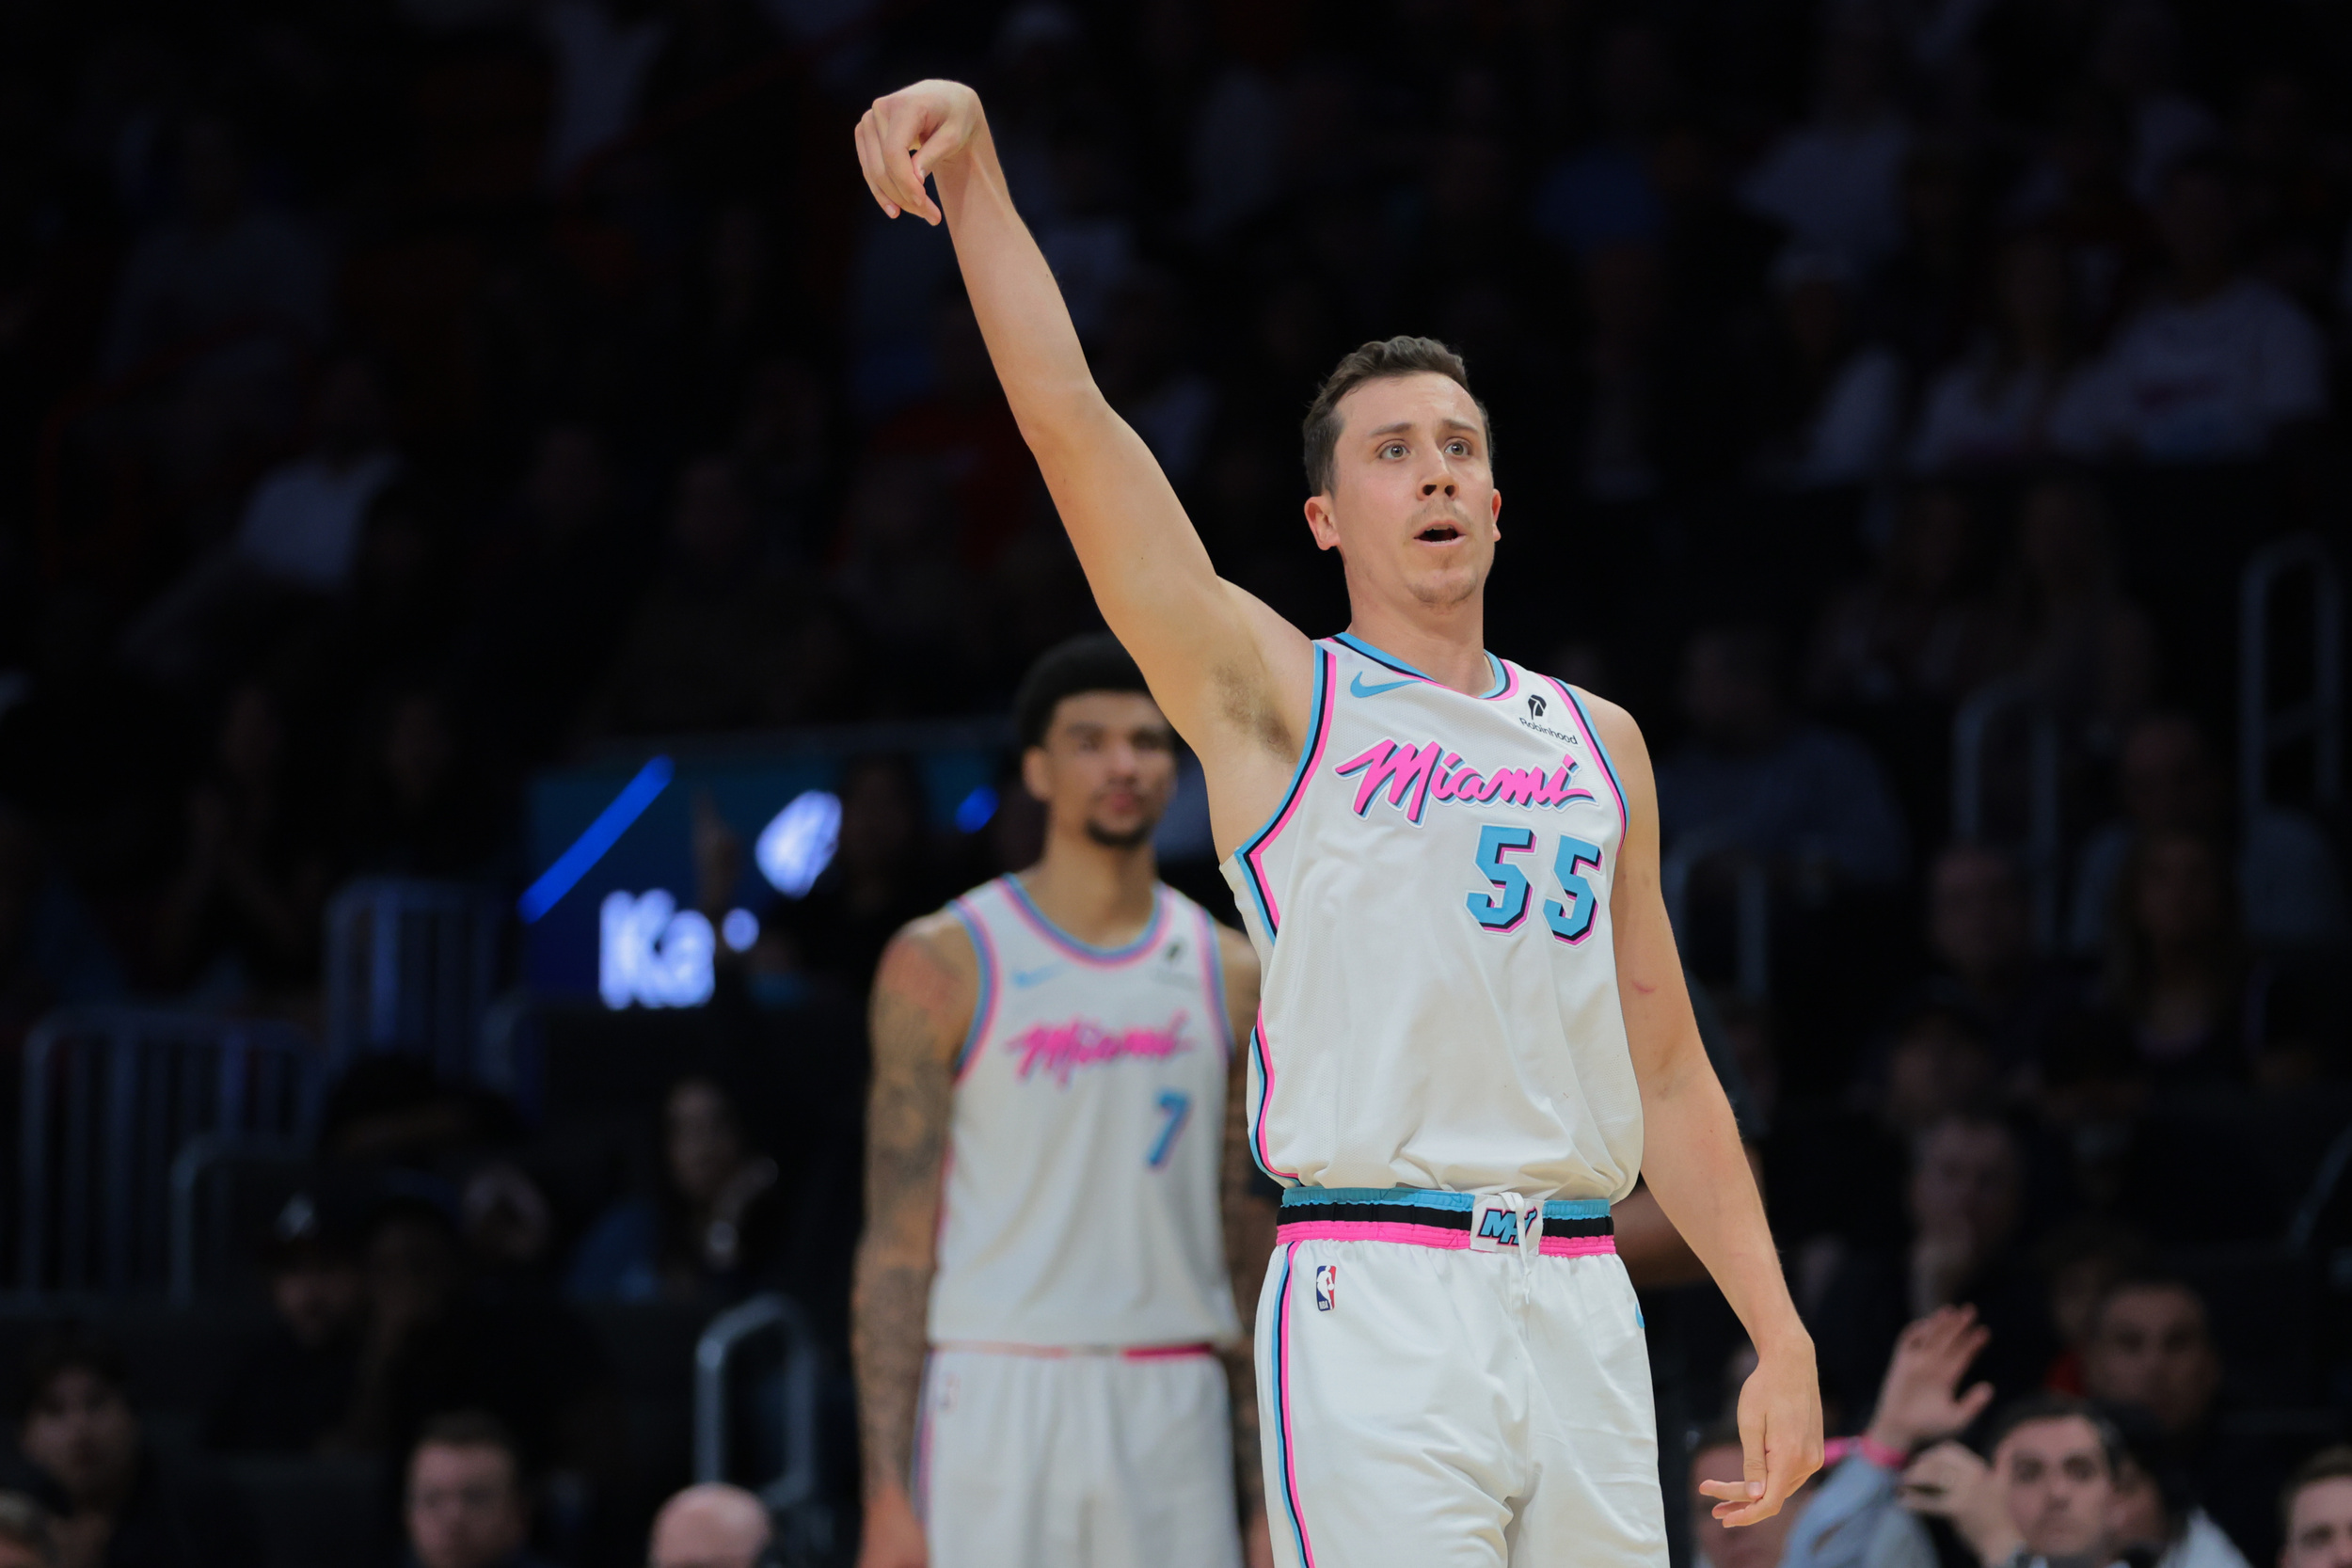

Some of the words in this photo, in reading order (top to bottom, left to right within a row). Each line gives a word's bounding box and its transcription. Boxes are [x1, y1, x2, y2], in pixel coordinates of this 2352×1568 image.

[1519, 717, 1579, 745] Robinhood
[1334, 738, 1596, 826] Miami
[1466, 824, 1603, 946] 55
[1147, 1091, 1192, 1168] 7
[1318, 1300, 1329, 1310] NBA
